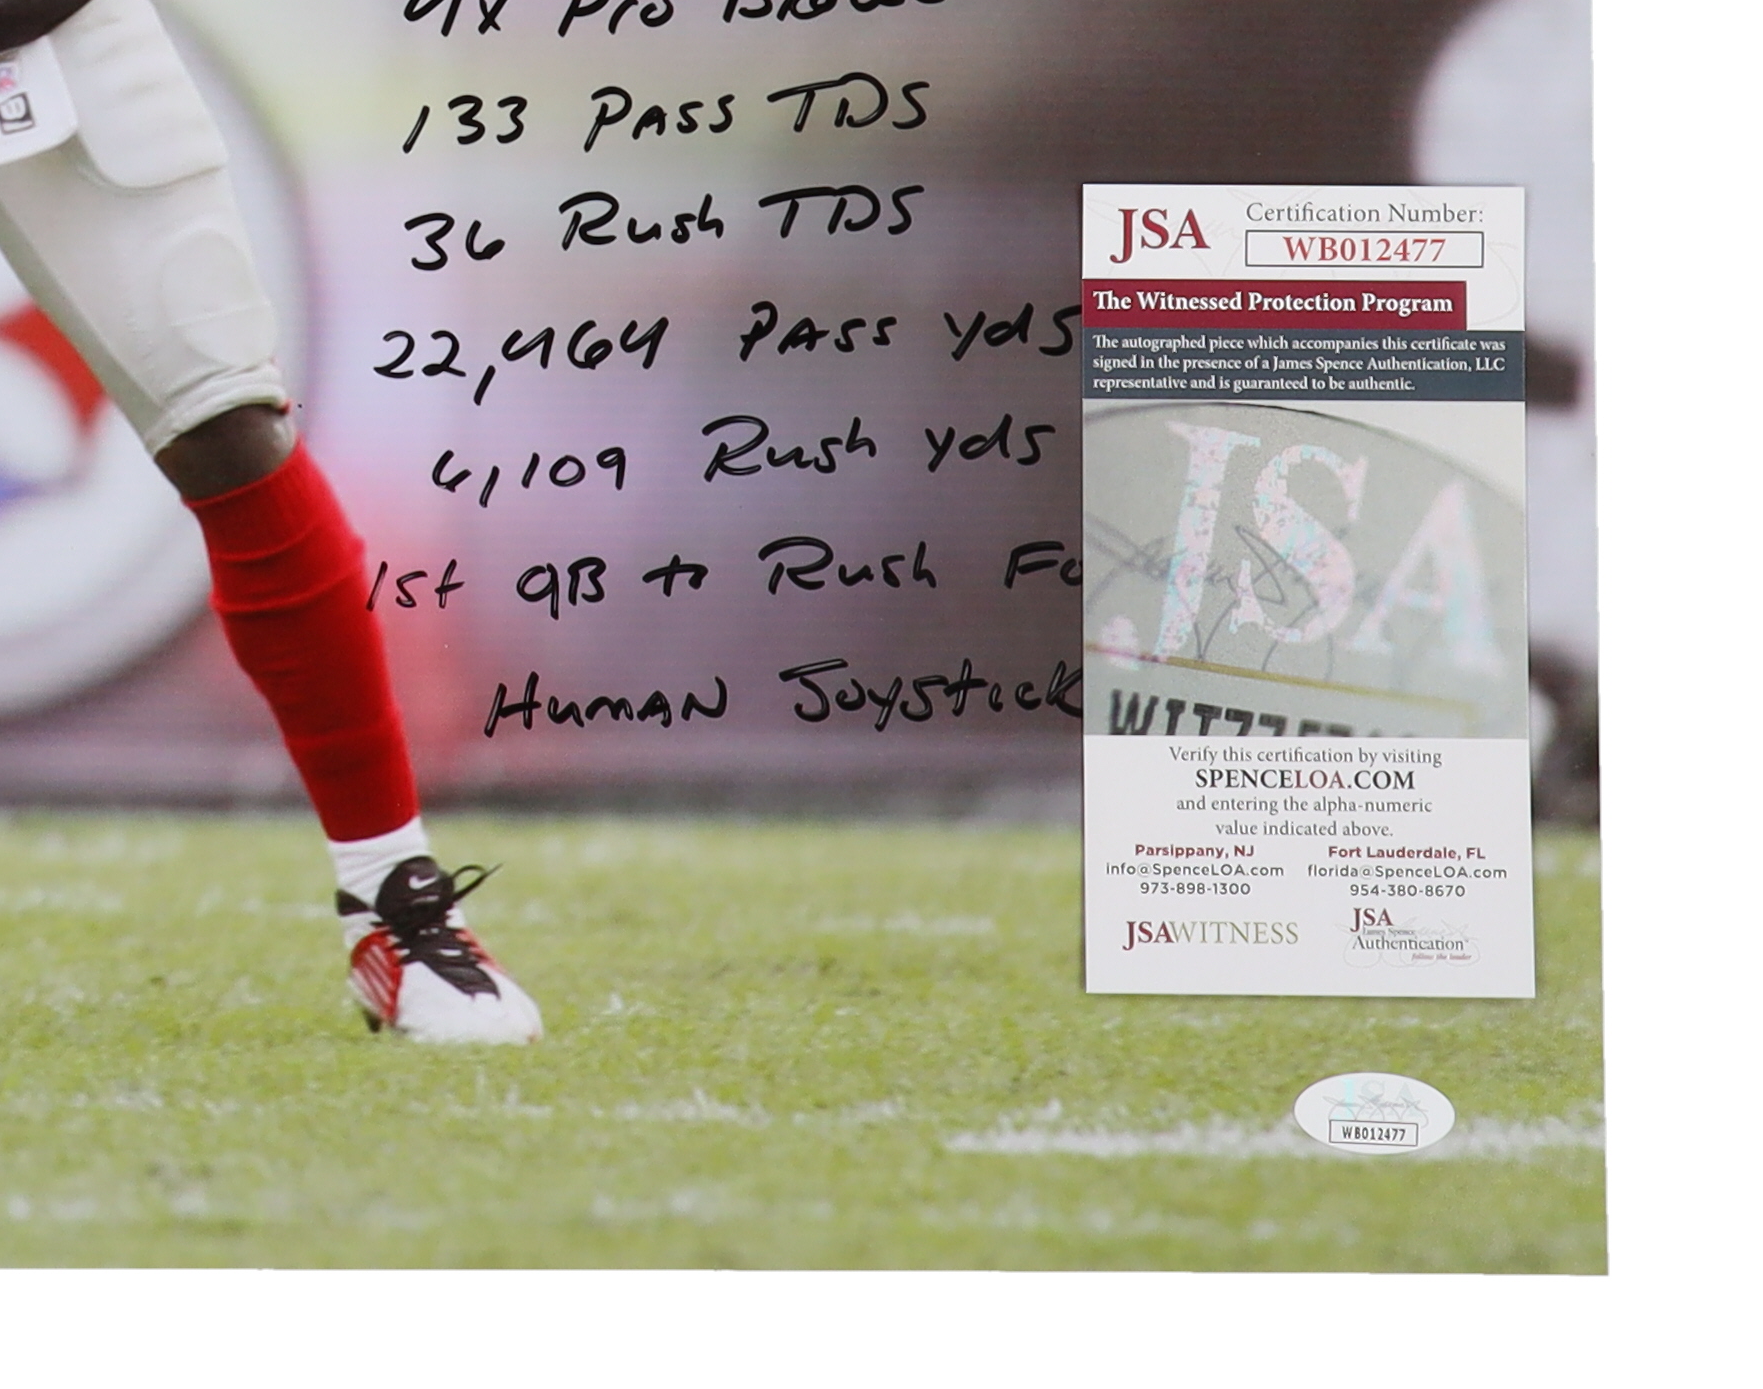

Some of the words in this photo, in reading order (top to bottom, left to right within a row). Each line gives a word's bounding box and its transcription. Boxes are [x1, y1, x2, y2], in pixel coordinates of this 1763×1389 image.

[403, 94, 528, 153] 133
[1247, 202, 1379, 221] Certification
[1389, 203, 1482, 222] Number:
[404, 212, 506, 271] 36
[559, 190, 726, 250] Rush
[1110, 209, 1210, 263] JSA
[1282, 236, 1448, 263] WB012477
[1093, 291, 1131, 309] The
[1137, 292, 1242, 310] Witnessed
[1249, 292, 1356, 311] Protection
[1362, 293, 1452, 314] Program
[1093, 335, 1118, 348] The
[1122, 335, 1207, 352] autographed
[1209, 336, 1244, 354] piece
[1247, 335, 1288, 349] which
[1292, 337, 1378, 353] accompanies
[1383, 336, 1407, 350] this
[1411, 337, 1476, 350] certificate
[1480, 341, 1505, 350] was
[1093, 355, 1138, 372] signed
[1141, 356, 1154, 368] in
[1158, 355, 1180, 368] the
[1183, 359, 1241, 376] presence
[1245, 355, 1260, 369] of
[1262, 360, 1269, 369] a
[1273, 356, 1312, 371] James
[1316, 357, 1363, 373] Spence
[1367, 356, 1471, 371] Authentication,
[1476, 357, 1504, 370] LLC
[1093, 376, 1187, 392] representative
[1191, 375, 1215, 389] and
[1219, 376, 1230, 389] is
[1234, 376, 1309, 393] guaranteed
[1312, 379, 1325, 389] to
[1329, 376, 1345, 389] be
[1349, 376, 1415, 390] authentic.
[702, 413, 877, 481] Rush
[758, 536, 937, 595] Rush
[1169, 746, 1217, 765] Verify
[1223, 746, 1251, 761] this
[1257, 747, 1352, 762] certification
[1359, 748, 1377, 767] by
[1383, 749, 1442, 768] visiting
[1196, 769, 1414, 789] SPENCELOA.COM
[1177, 795, 1205, 810] and
[1212, 797, 1278, 815] entering
[1284, 796, 1308, 811] the
[1314, 796, 1431, 816] alpha-numeric
[1216, 820, 1257, 835] value
[1264, 820, 1336, 835] indicated
[1343, 821, 1392, 836] above.
[1135, 844, 1228, 859] Parsippany,
[1234, 845, 1254, 857] NJ
[1329, 846, 1361, 858] Fort
[1367, 847, 1461, 861] Lauderdale,
[1467, 847, 1485, 859] FL
[1107, 862, 1283, 877] info@SpenceLOA.com
[1308, 864, 1506, 879] florida@SpenceLOA.com
[1141, 882, 1250, 895] 973-898-1300
[1350, 884, 1465, 897] 954-380-8670
[1349, 907, 1394, 933] JSA
[1341, 1125, 1406, 1142] WB012477
